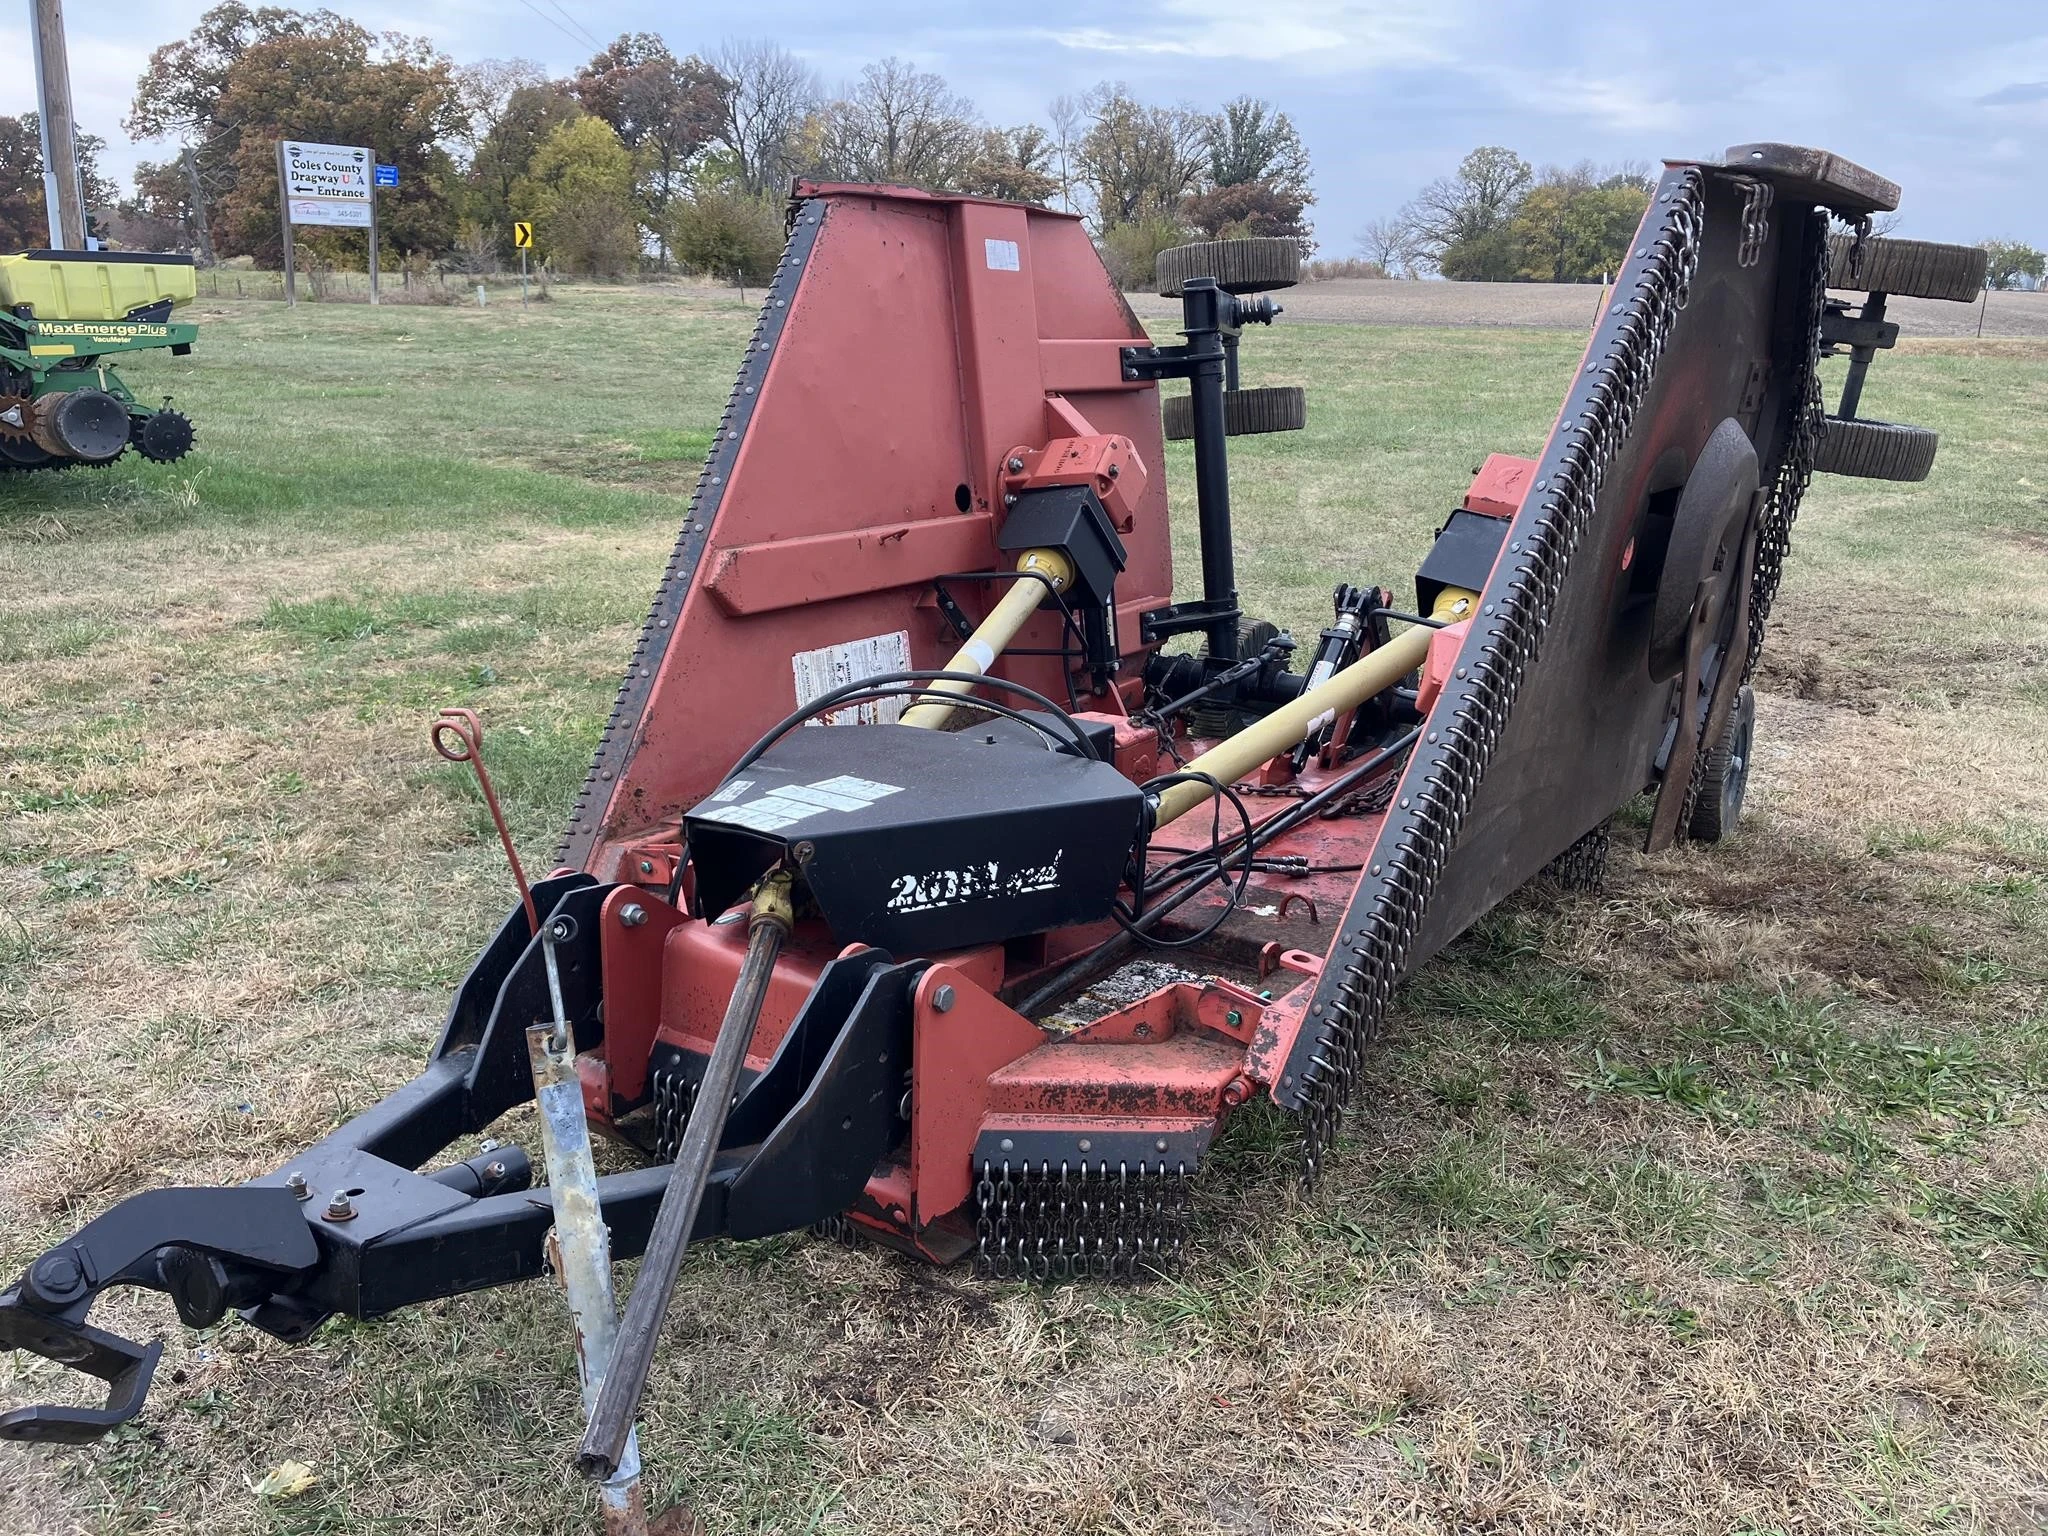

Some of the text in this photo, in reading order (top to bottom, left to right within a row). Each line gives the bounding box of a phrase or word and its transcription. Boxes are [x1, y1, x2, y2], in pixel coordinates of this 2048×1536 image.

[292, 159, 321, 170] Coles
[324, 161, 362, 175] County
[291, 171, 339, 185] Dragway
[317, 186, 365, 197] Entrance
